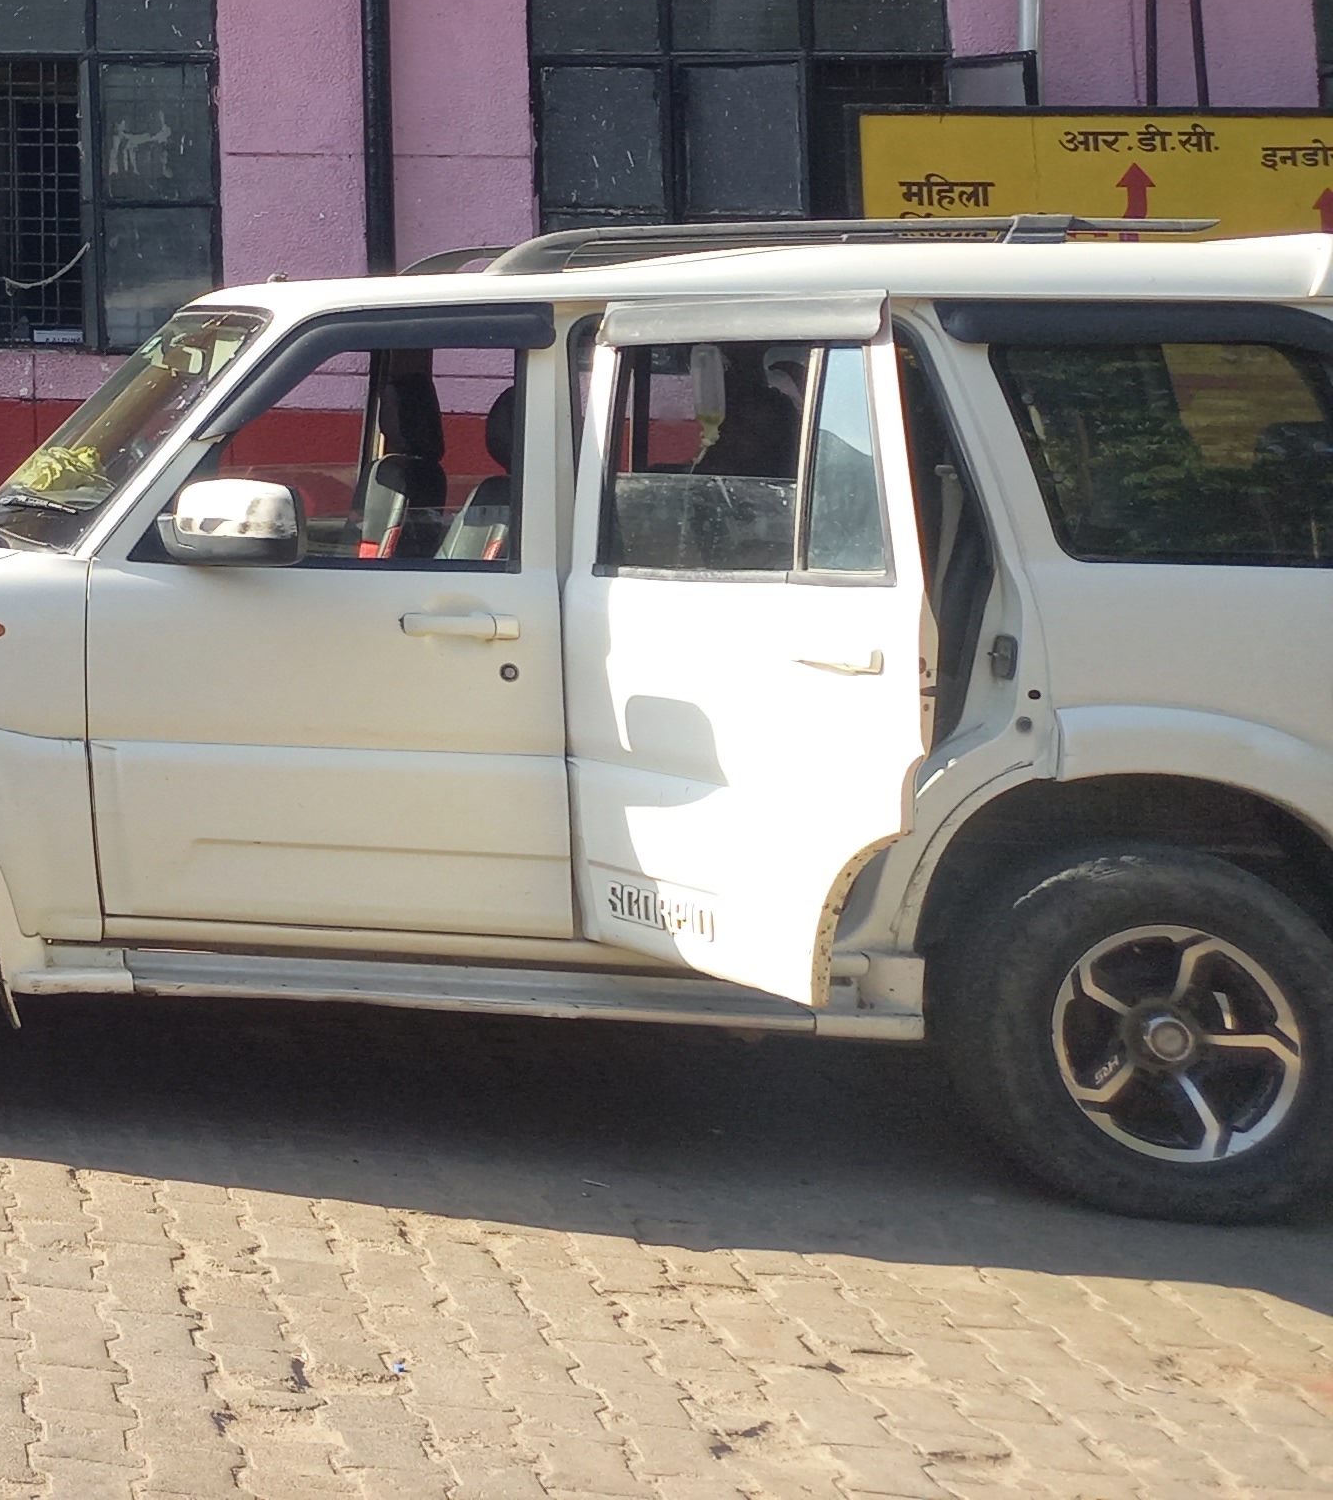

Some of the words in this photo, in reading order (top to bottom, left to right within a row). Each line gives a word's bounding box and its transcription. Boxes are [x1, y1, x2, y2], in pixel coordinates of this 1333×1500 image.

[1058, 123, 1220, 153] आर.डी.सी.
[1261, 138, 1333, 172] इनडो
[898, 172, 996, 211] महिला
